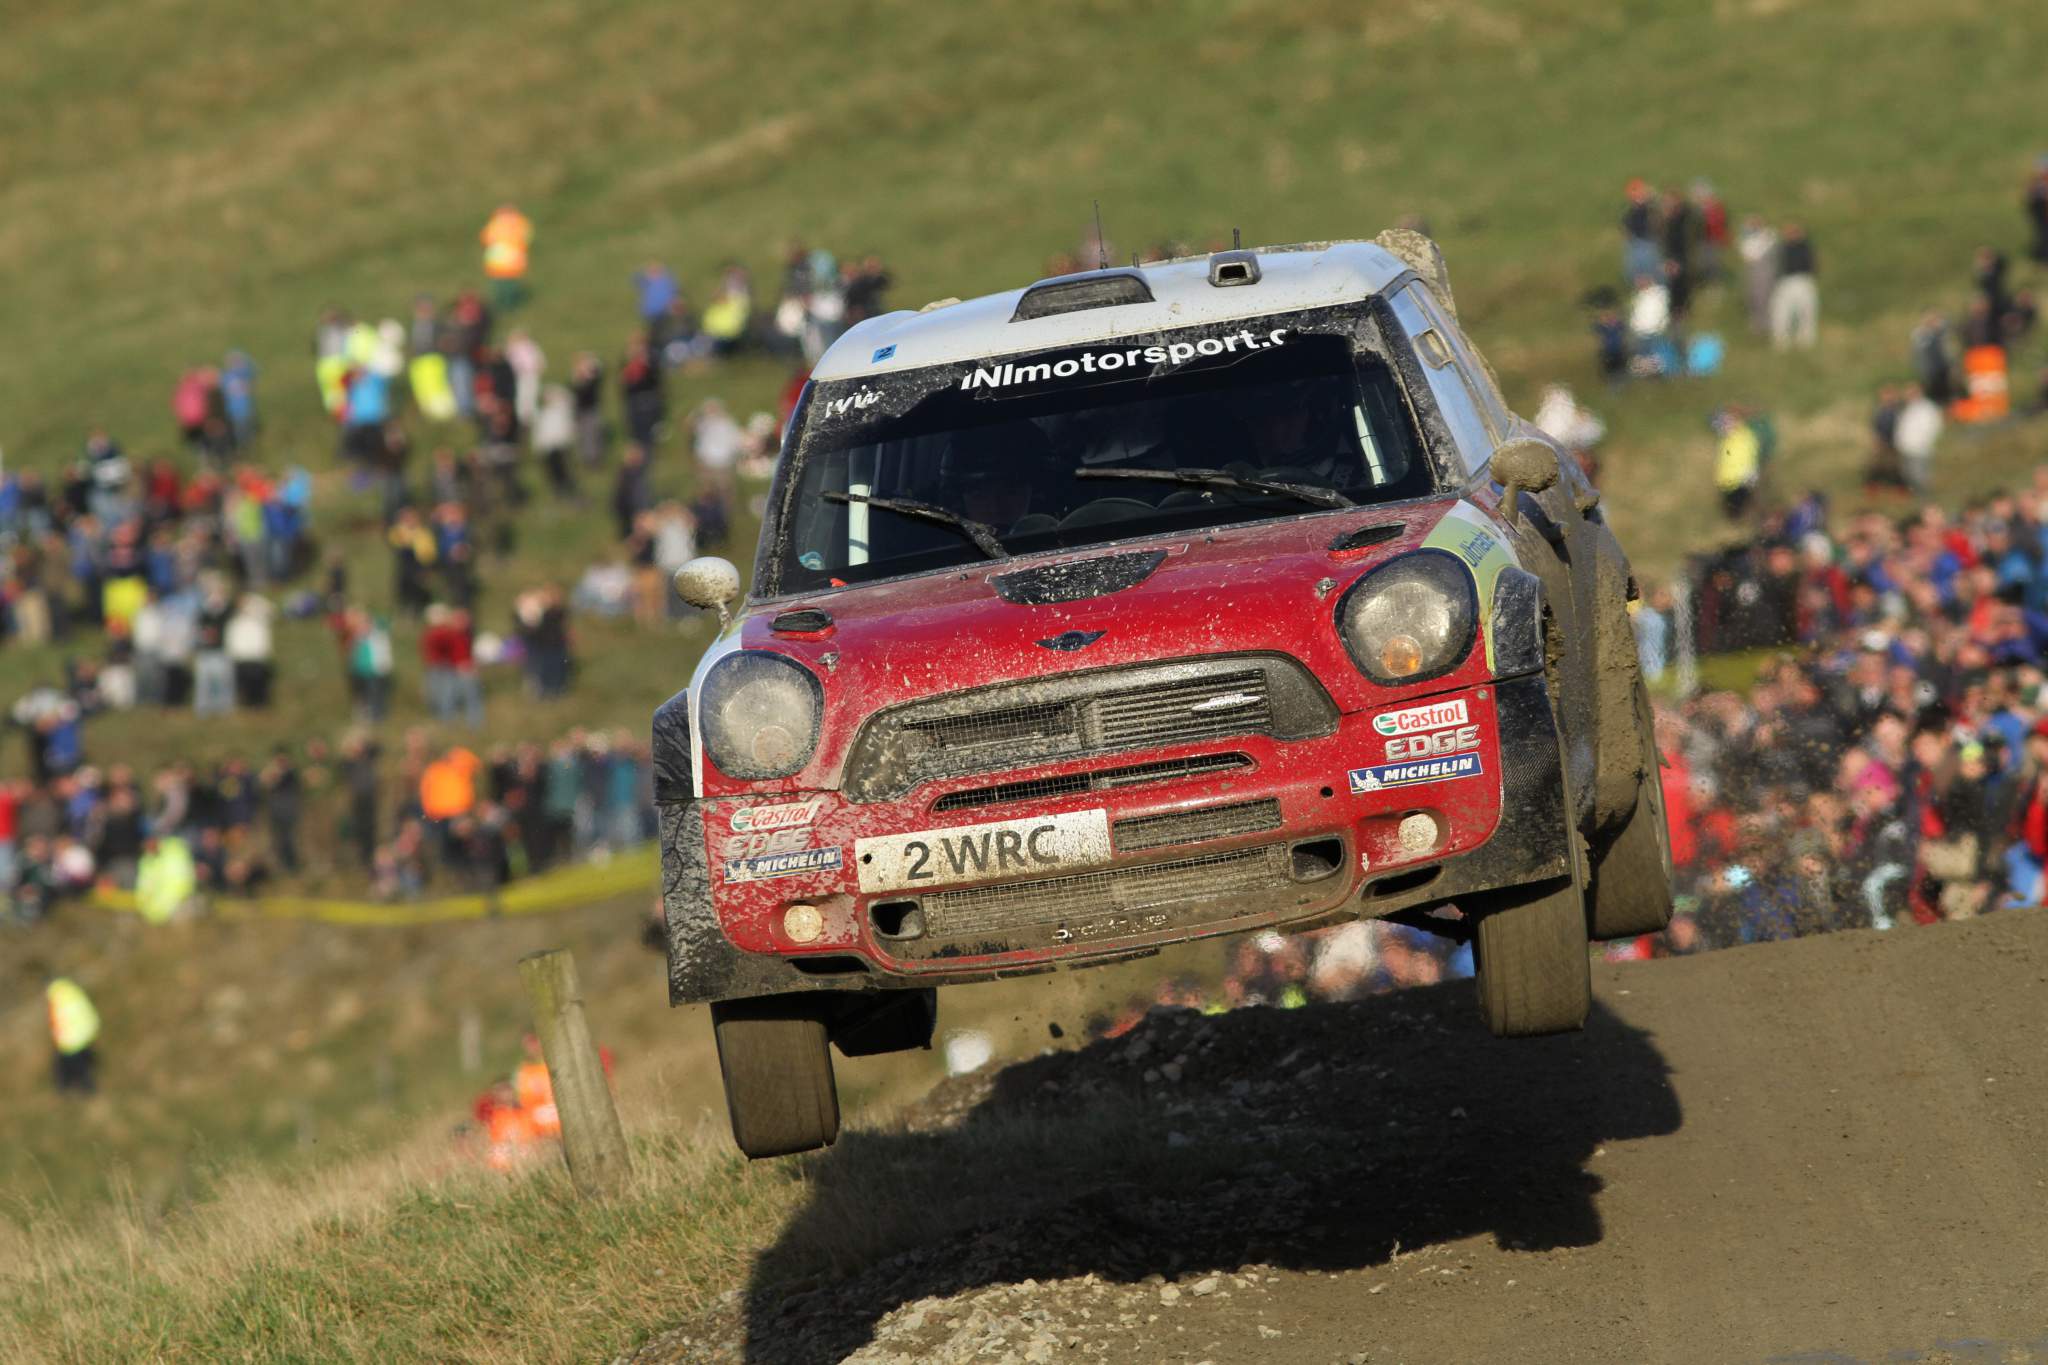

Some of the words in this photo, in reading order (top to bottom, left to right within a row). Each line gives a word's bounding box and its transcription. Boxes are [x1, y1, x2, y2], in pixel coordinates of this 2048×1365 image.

[960, 328, 1289, 391] INImotorsport.c
[1396, 703, 1463, 731] Castrol
[1385, 724, 1481, 762] EDGE
[1383, 757, 1473, 782] MICHELIN
[751, 804, 811, 828] Castrol
[755, 851, 836, 873] MICHELIN
[903, 841, 934, 880] 2
[940, 825, 1060, 875] WRC
